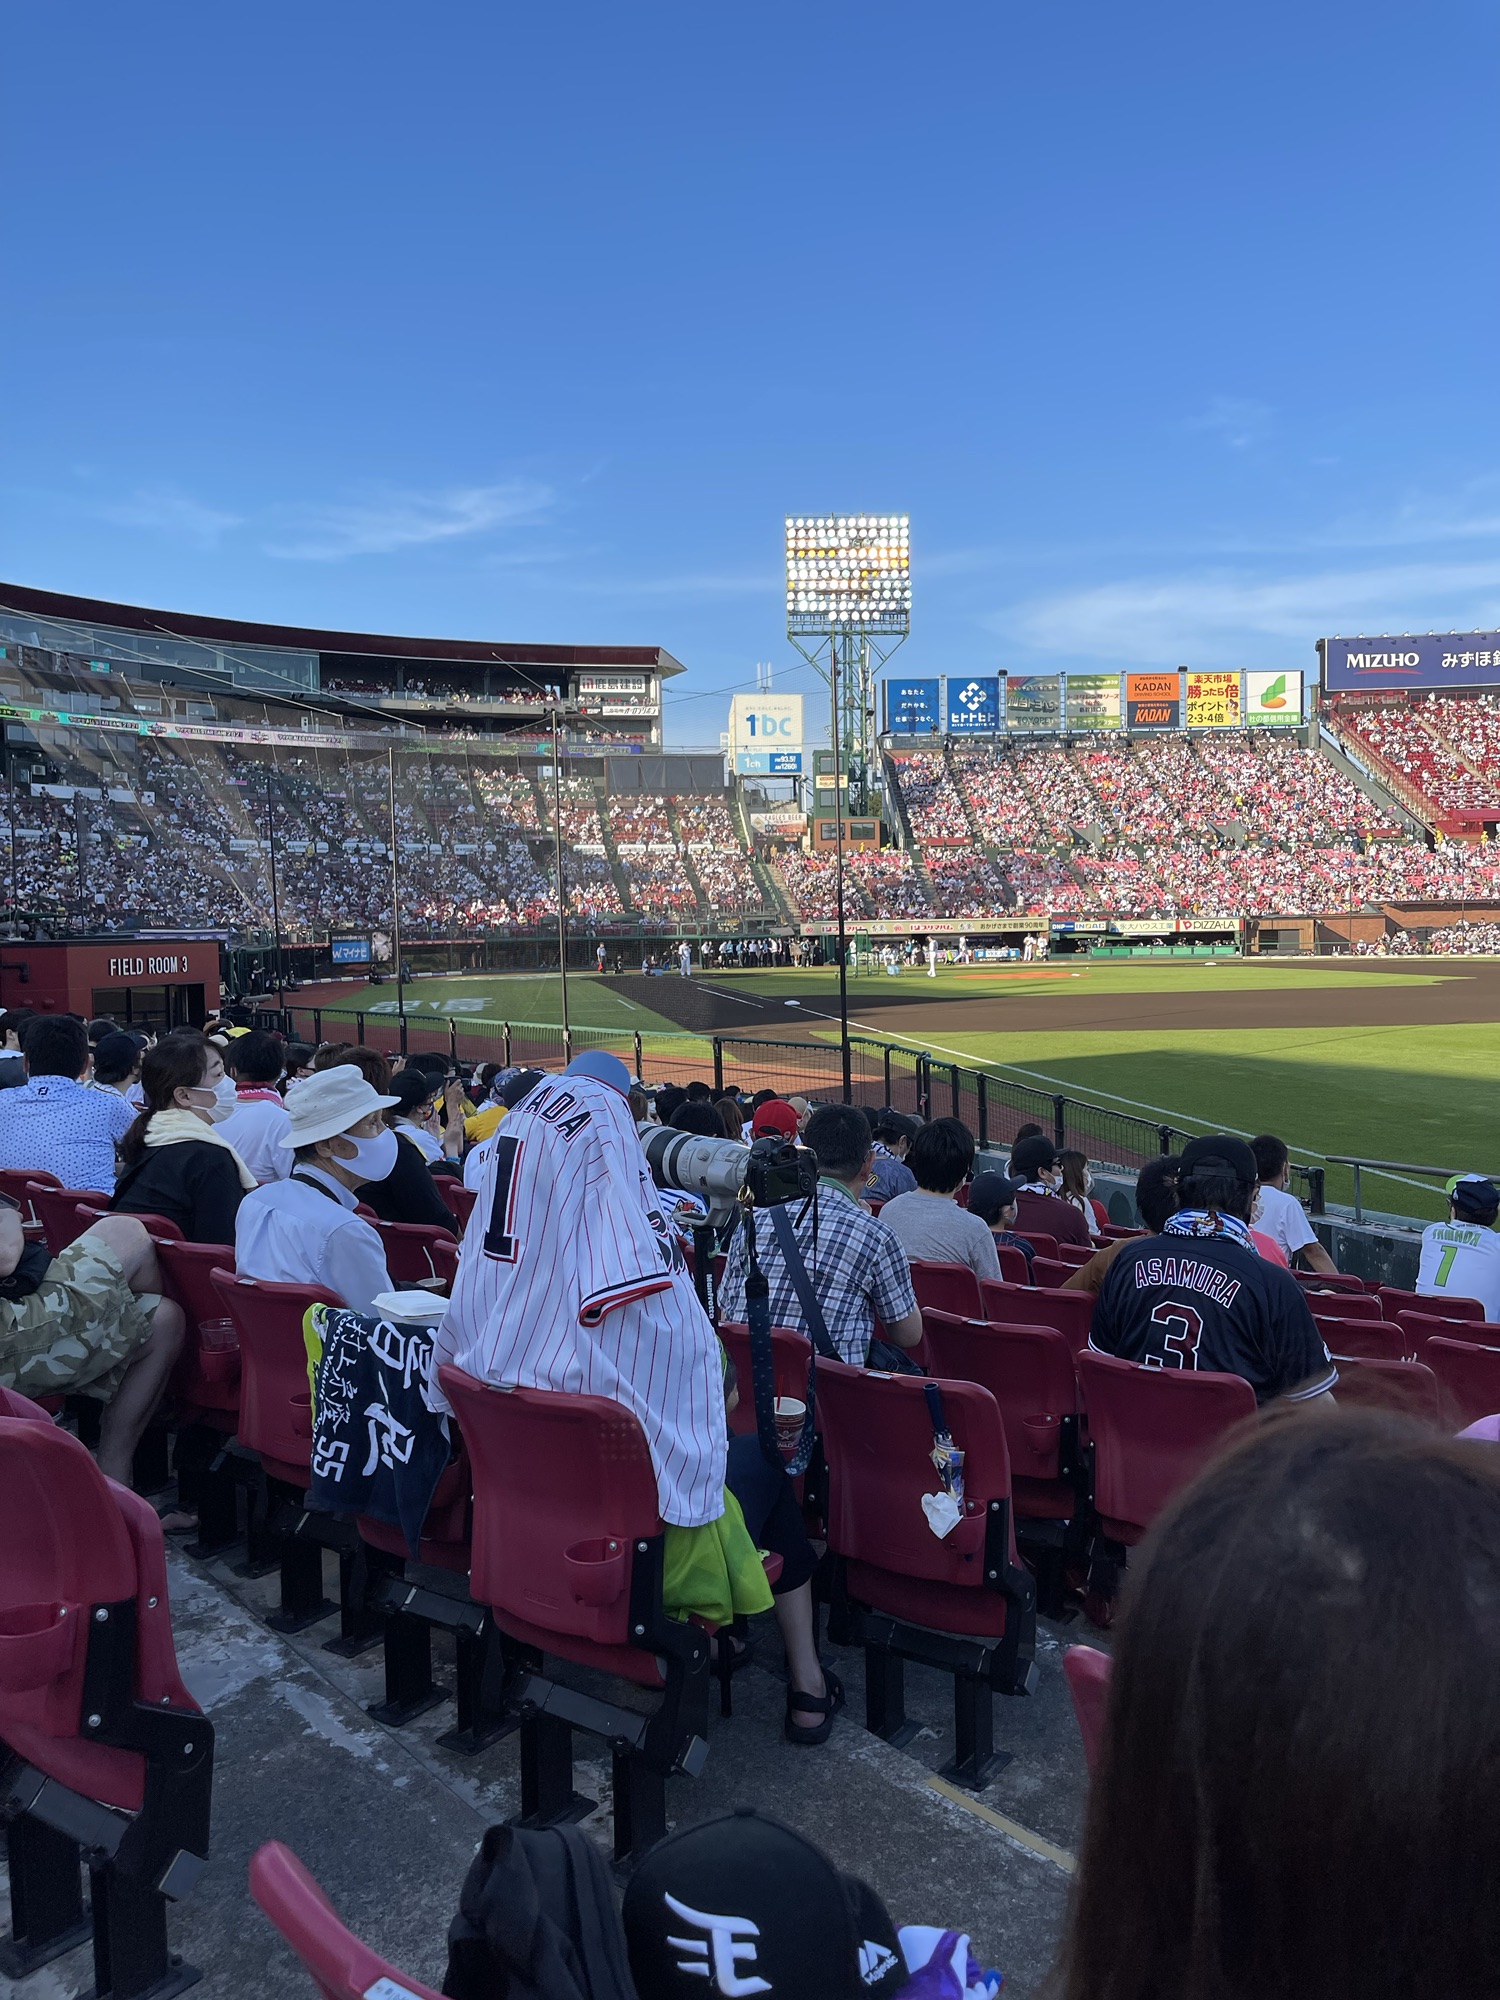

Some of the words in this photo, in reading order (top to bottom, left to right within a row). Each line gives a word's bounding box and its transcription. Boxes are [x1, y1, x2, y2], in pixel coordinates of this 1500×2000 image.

[1346, 652, 1420, 668] MIZUHO
[594, 678, 643, 690] 鹿島建設
[1194, 674, 1232, 684] 楽天市場
[1134, 682, 1172, 691] KADAN
[1187, 684, 1239, 699] 勝ったら倍
[1187, 702, 1224, 712] ポイント
[951, 712, 995, 723] ヒトトヒト
[1015, 716, 1053, 725] TOYOPET
[1134, 708, 1172, 722] KADAN
[1249, 714, 1298, 723] 杜の都信用金庫
[980, 922, 1044, 930] おかげさまで創業90周年
[342, 948, 368, 958] マイナビ
[110, 958, 144, 976] FIELD
[148, 957, 178, 974] ROOM
[182, 956, 188, 973] 3
[511, 1085, 592, 1143] ADA
[483, 1134, 525, 1264] 1
[1135, 1258, 1241, 1309] ASAMURA
[1146, 1300, 1203, 1371] 3
[312, 1436, 350, 1482] 55
[863, 1954, 899, 1986] Majestic
